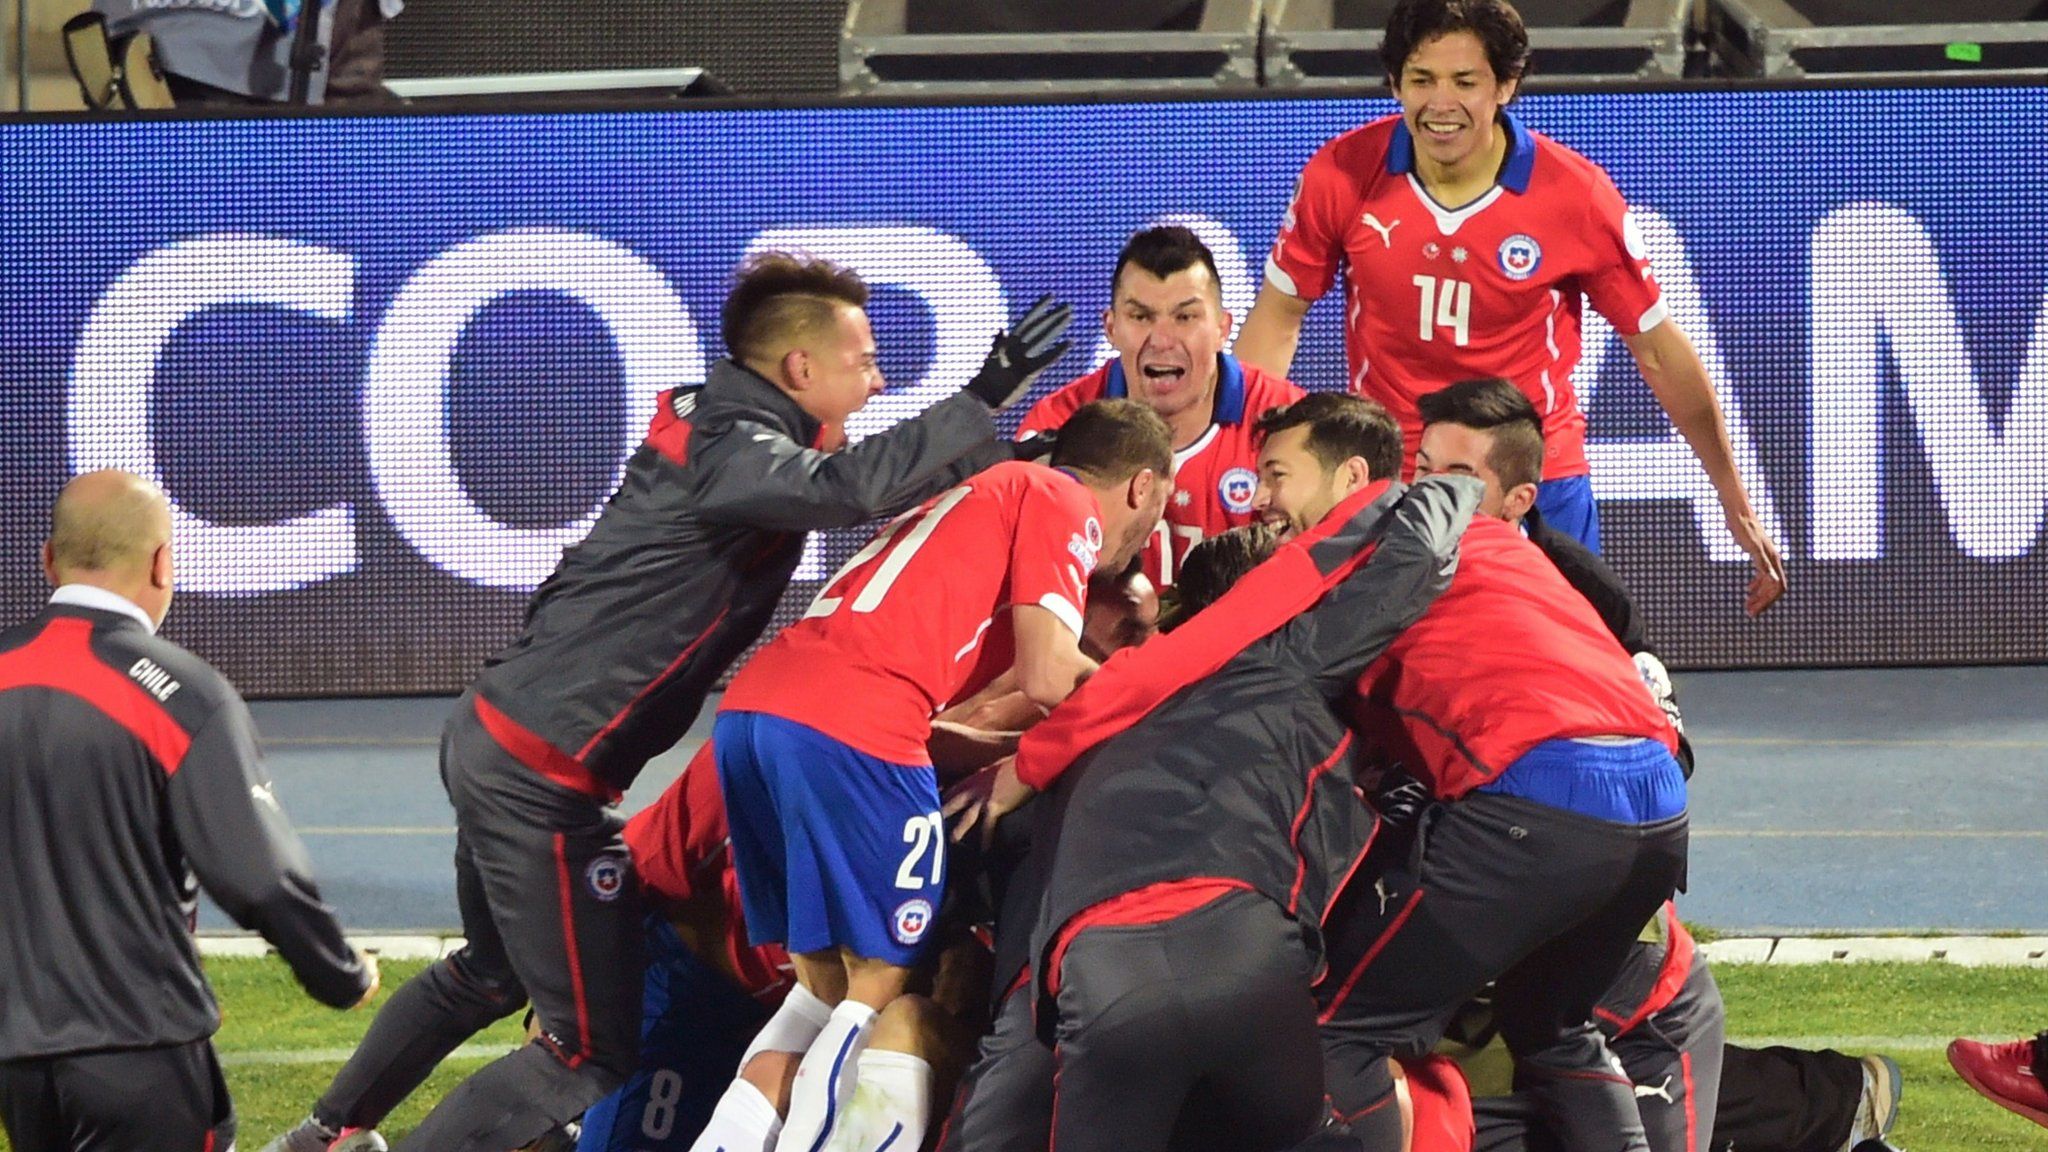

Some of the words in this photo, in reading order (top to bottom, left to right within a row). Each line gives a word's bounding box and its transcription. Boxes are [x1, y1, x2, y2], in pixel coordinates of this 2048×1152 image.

[1413, 274, 1471, 346] 14
[802, 485, 973, 619] 21
[1144, 518, 1203, 586] 17
[128, 657, 181, 702] CHILE
[895, 811, 944, 889] 21
[641, 1069, 682, 1139] 8
